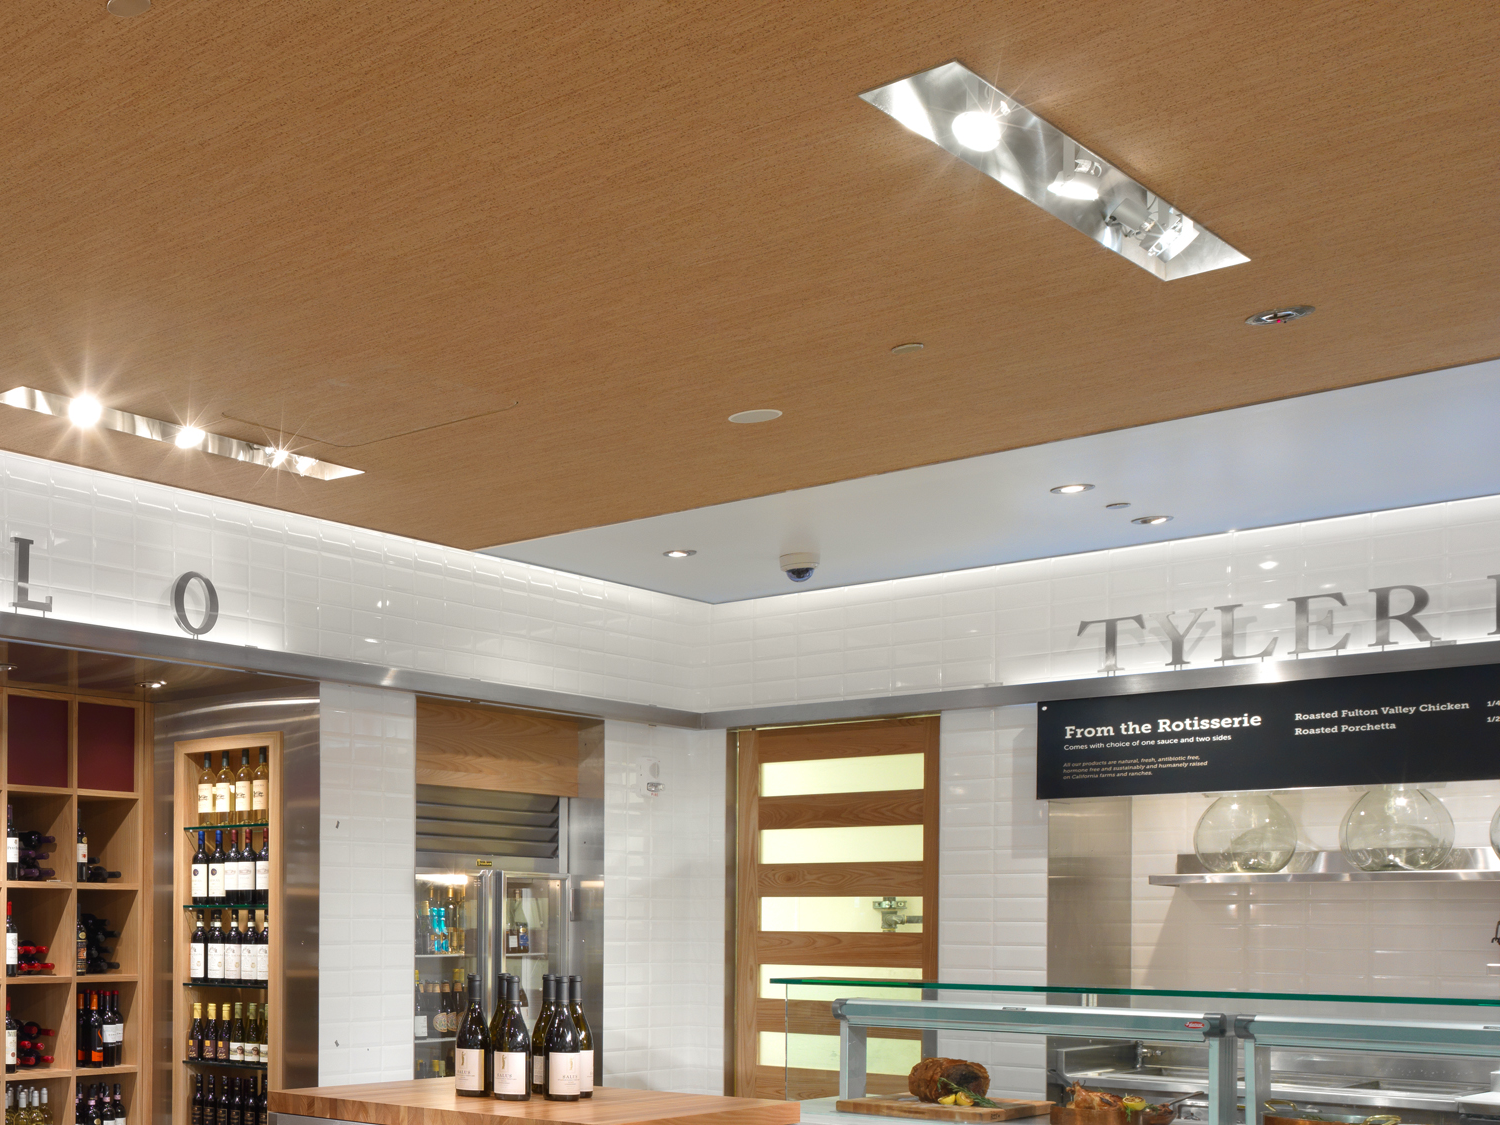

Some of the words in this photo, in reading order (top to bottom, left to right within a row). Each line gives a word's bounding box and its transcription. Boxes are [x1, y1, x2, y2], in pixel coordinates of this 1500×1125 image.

[1077, 584, 1442, 673] TYLER
[1294, 710, 1338, 721] Roasted
[1341, 708, 1378, 718] Fulton
[1381, 705, 1416, 716] Valley
[1419, 702, 1470, 712] Chicken
[1064, 725, 1115, 739] From
[1120, 721, 1152, 735] the
[1157, 713, 1262, 733] Rotisserie
[1294, 725, 1338, 736] Roasted
[1341, 722, 1397, 733] Porchetta
[1064, 743, 1088, 751] Comes
[1106, 740, 1130, 748] choice
[1157, 737, 1178, 745] sauce
[1180, 735, 1194, 743] and
